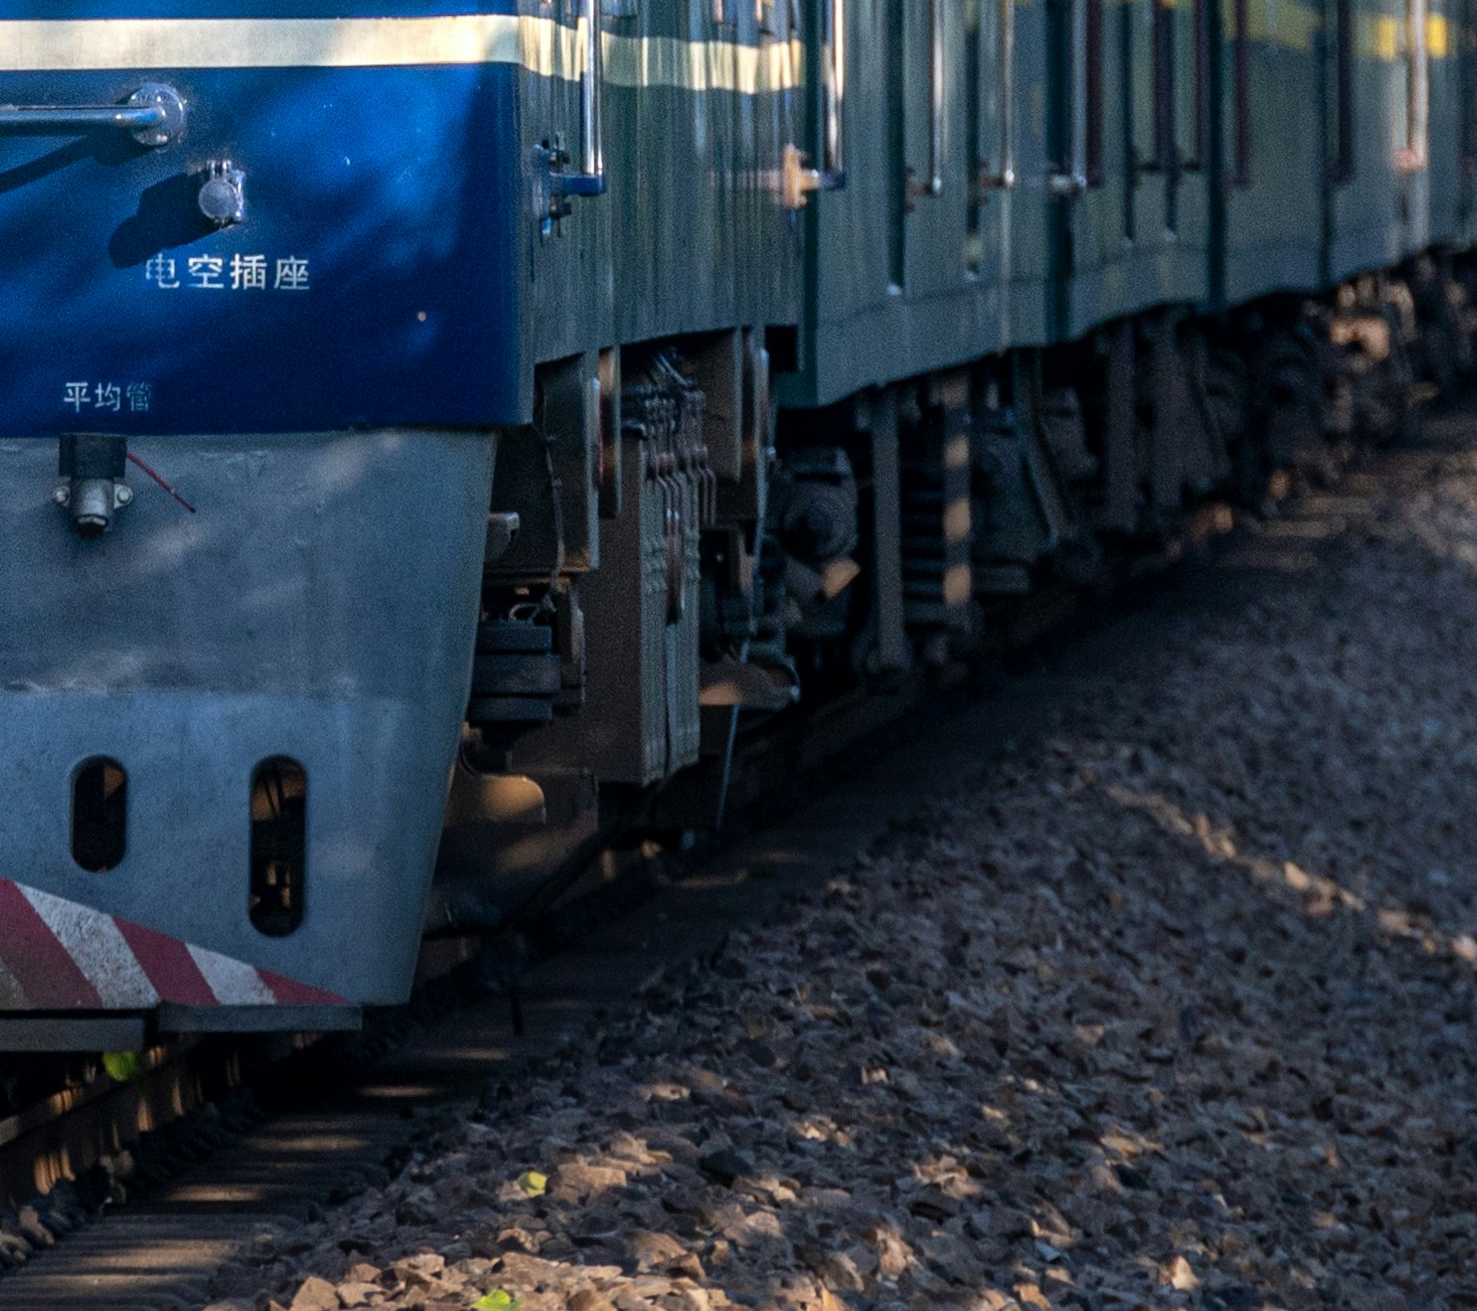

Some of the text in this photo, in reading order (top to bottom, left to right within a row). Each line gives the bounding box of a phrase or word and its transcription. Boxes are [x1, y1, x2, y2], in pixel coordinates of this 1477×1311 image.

[145, 253, 311, 291] 电空插座
[62, 380, 153, 413] 平均管
